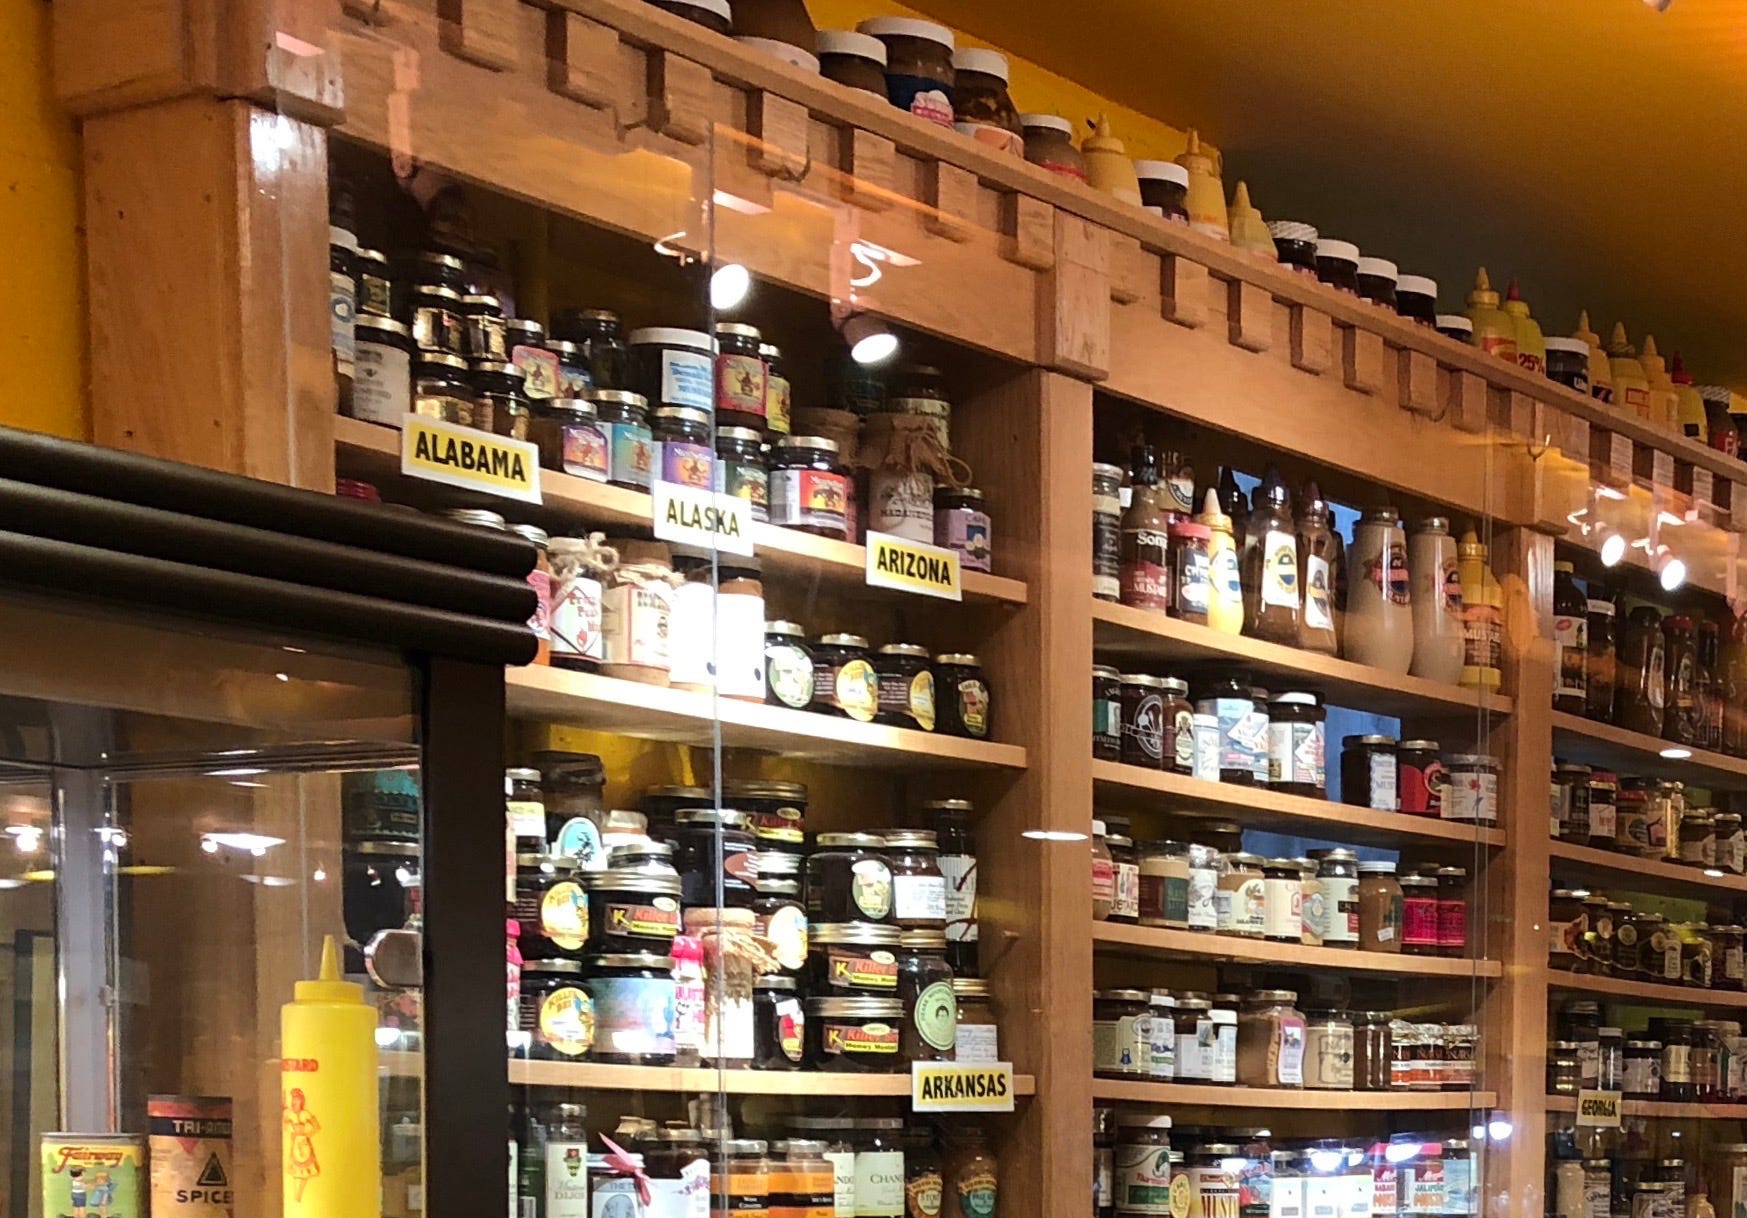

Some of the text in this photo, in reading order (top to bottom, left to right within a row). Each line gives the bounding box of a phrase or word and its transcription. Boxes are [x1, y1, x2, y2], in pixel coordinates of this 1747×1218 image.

[415, 431, 526, 482] ALABAMA
[667, 499, 739, 537] ALASKA
[877, 546, 951, 586] ARIZONA
[922, 1072, 1007, 1101] ARKANSAS
[52, 1146, 124, 1173] Fairway
